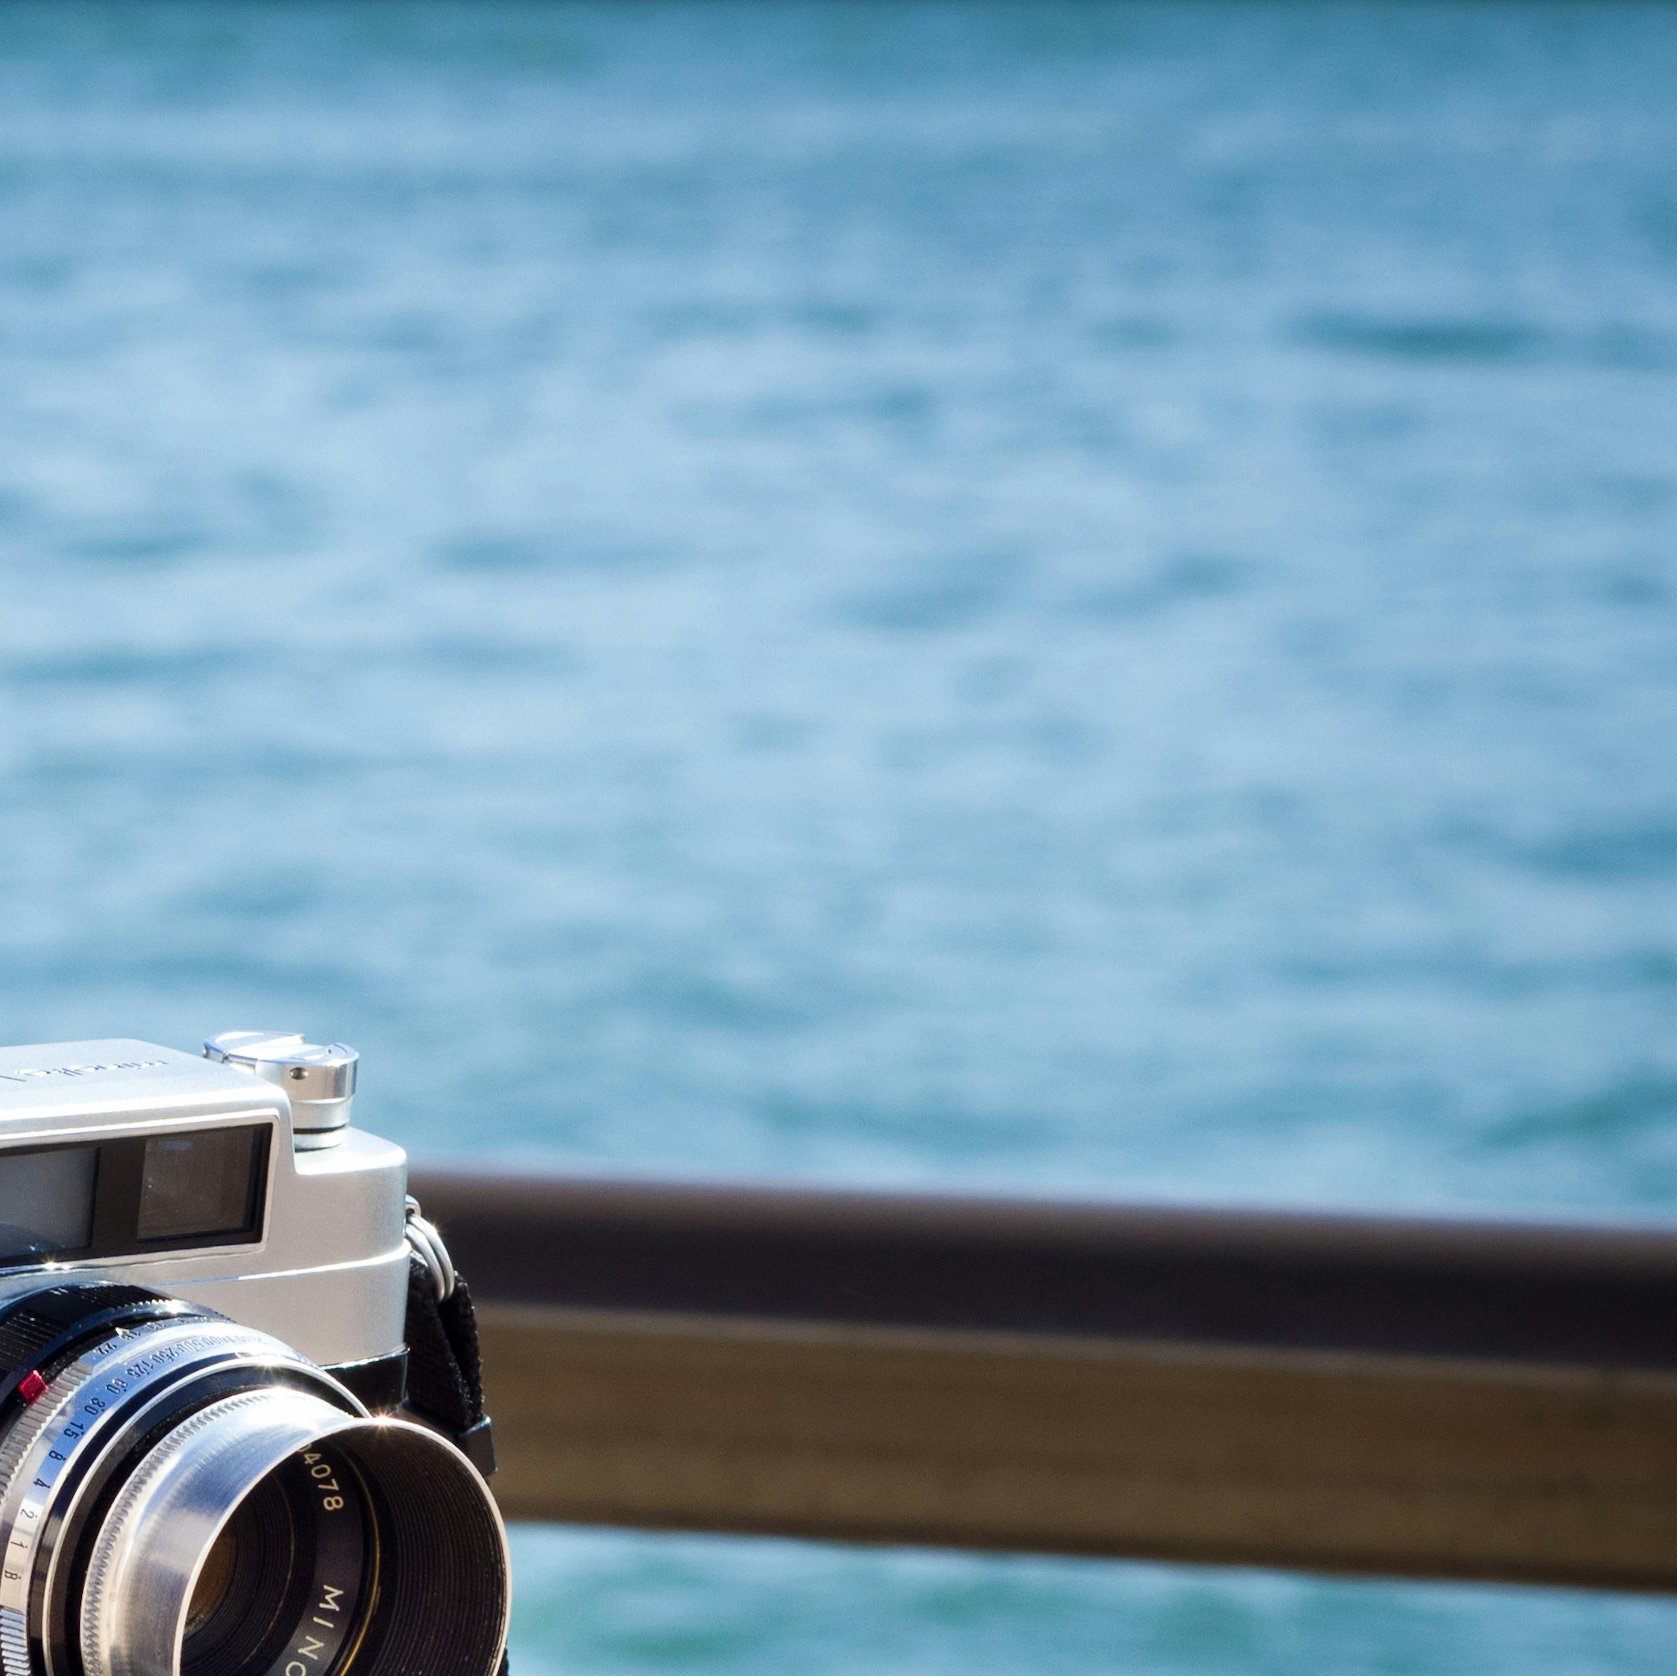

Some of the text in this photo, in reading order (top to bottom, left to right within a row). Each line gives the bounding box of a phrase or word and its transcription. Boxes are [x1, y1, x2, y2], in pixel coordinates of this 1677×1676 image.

[152, 1347, 180, 1366] 250
[126, 1359, 154, 1380] 125
[106, 1378, 128, 1395] 60
[84, 1397, 106, 1416] 30
[63, 1421, 84, 1440] 15
[48, 1450, 63, 1461] 8
[33, 1477, 50, 1489] 4
[20, 1508, 35, 1520] 2
[4, 1569, 19, 1582] B
